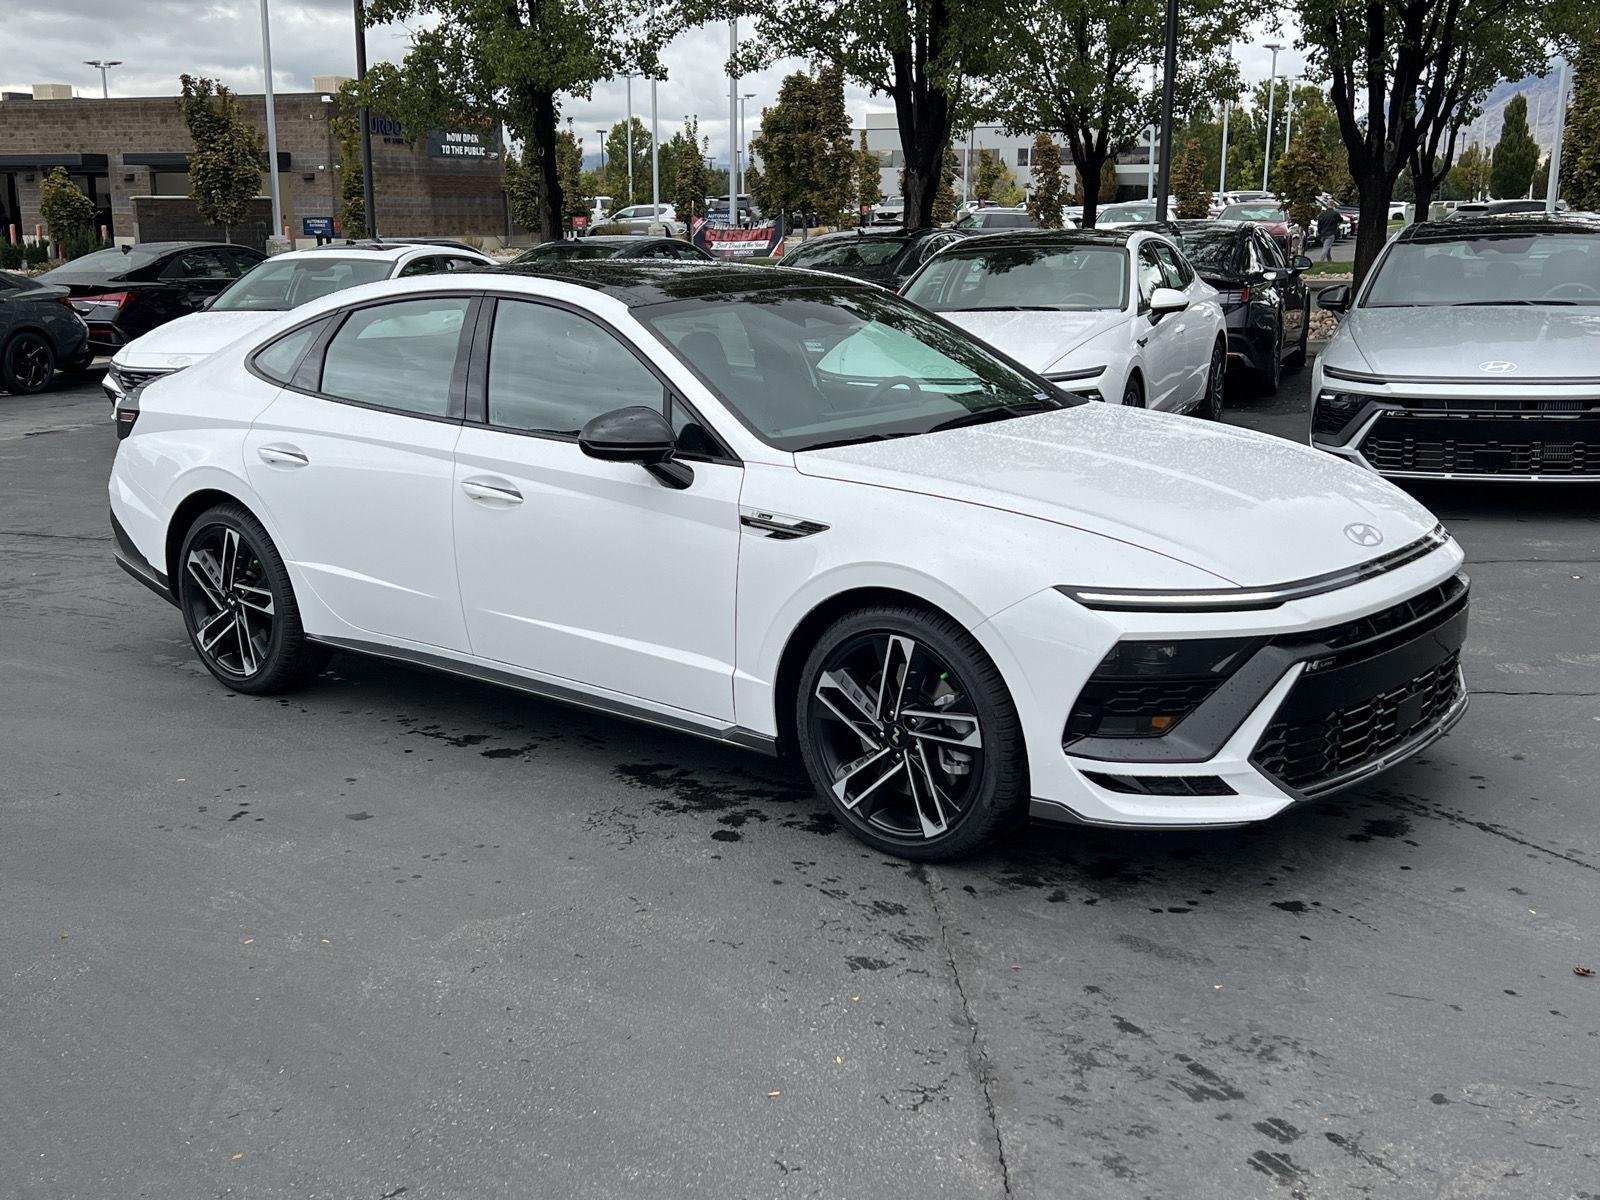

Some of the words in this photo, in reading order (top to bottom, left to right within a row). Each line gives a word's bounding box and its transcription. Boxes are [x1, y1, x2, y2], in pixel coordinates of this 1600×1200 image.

[446, 132, 462, 142] NOW
[462, 133, 479, 143] OPEN
[441, 145, 450, 154] TO
[451, 145, 463, 155] THE
[464, 146, 486, 156] PUBLIC
[704, 229, 774, 240] CLOSEOUT
